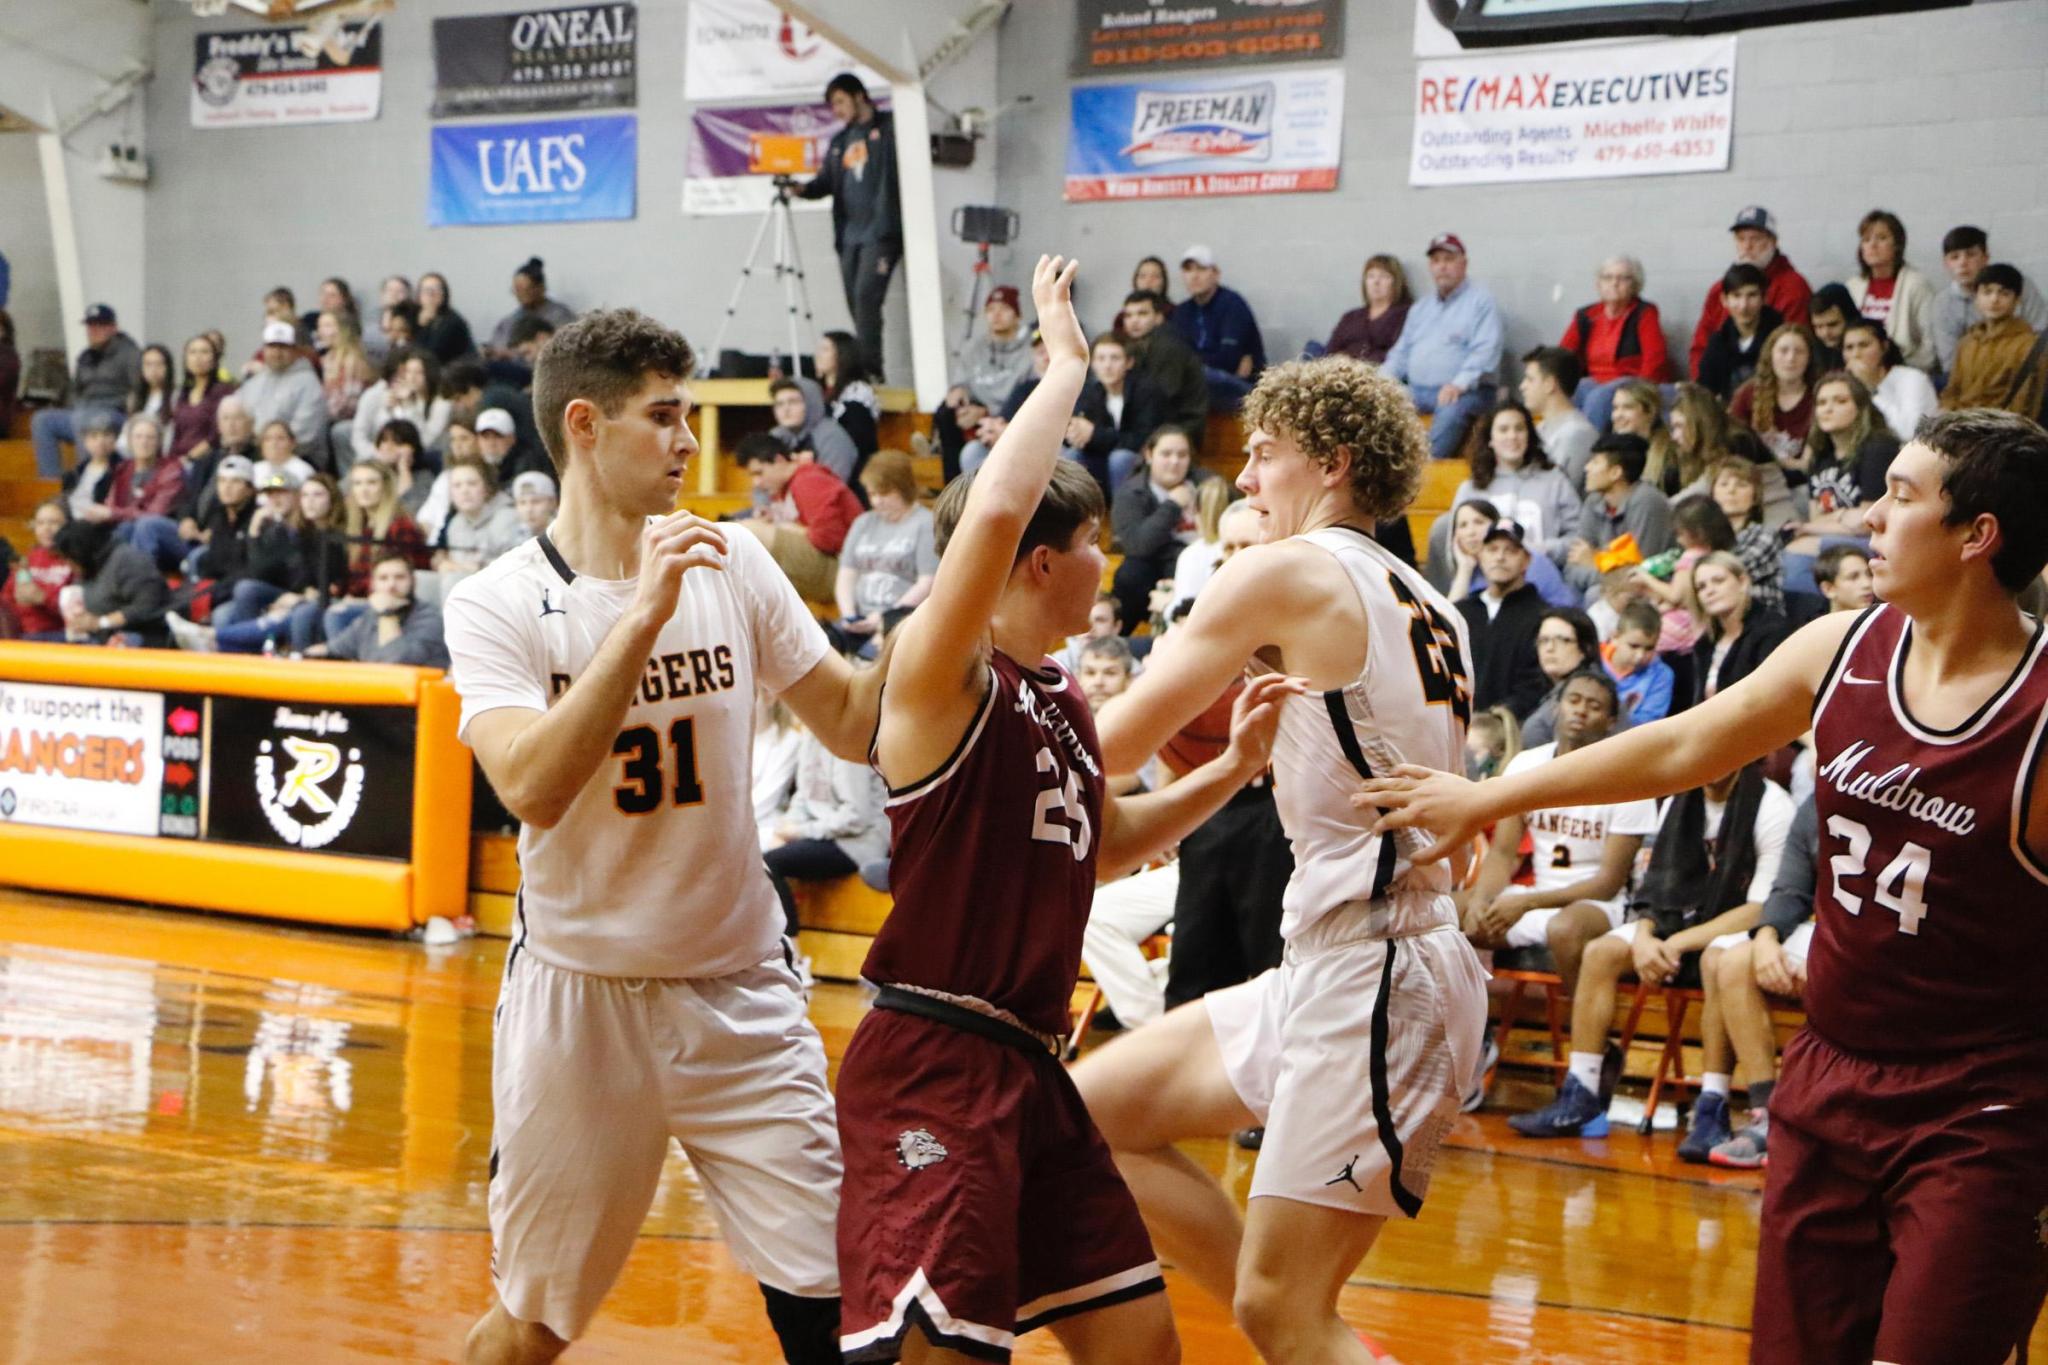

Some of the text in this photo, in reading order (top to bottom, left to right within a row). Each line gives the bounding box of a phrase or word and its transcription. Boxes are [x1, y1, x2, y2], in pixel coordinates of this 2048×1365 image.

[511, 6, 634, 51] O'NEAL
[1139, 95, 1268, 132] FREEMAN
[1420, 68, 1729, 114] RE/MAX EXECUTIVES
[478, 134, 586, 195] UAFS
[23, 697, 102, 721] support
[111, 699, 143, 724] the
[0, 727, 145, 785] ANGERS
[611, 714, 705, 818] 31
[1819, 739, 1976, 836] Muldrow
[1551, 843, 1571, 868] 2
[1826, 813, 1931, 936] 24
